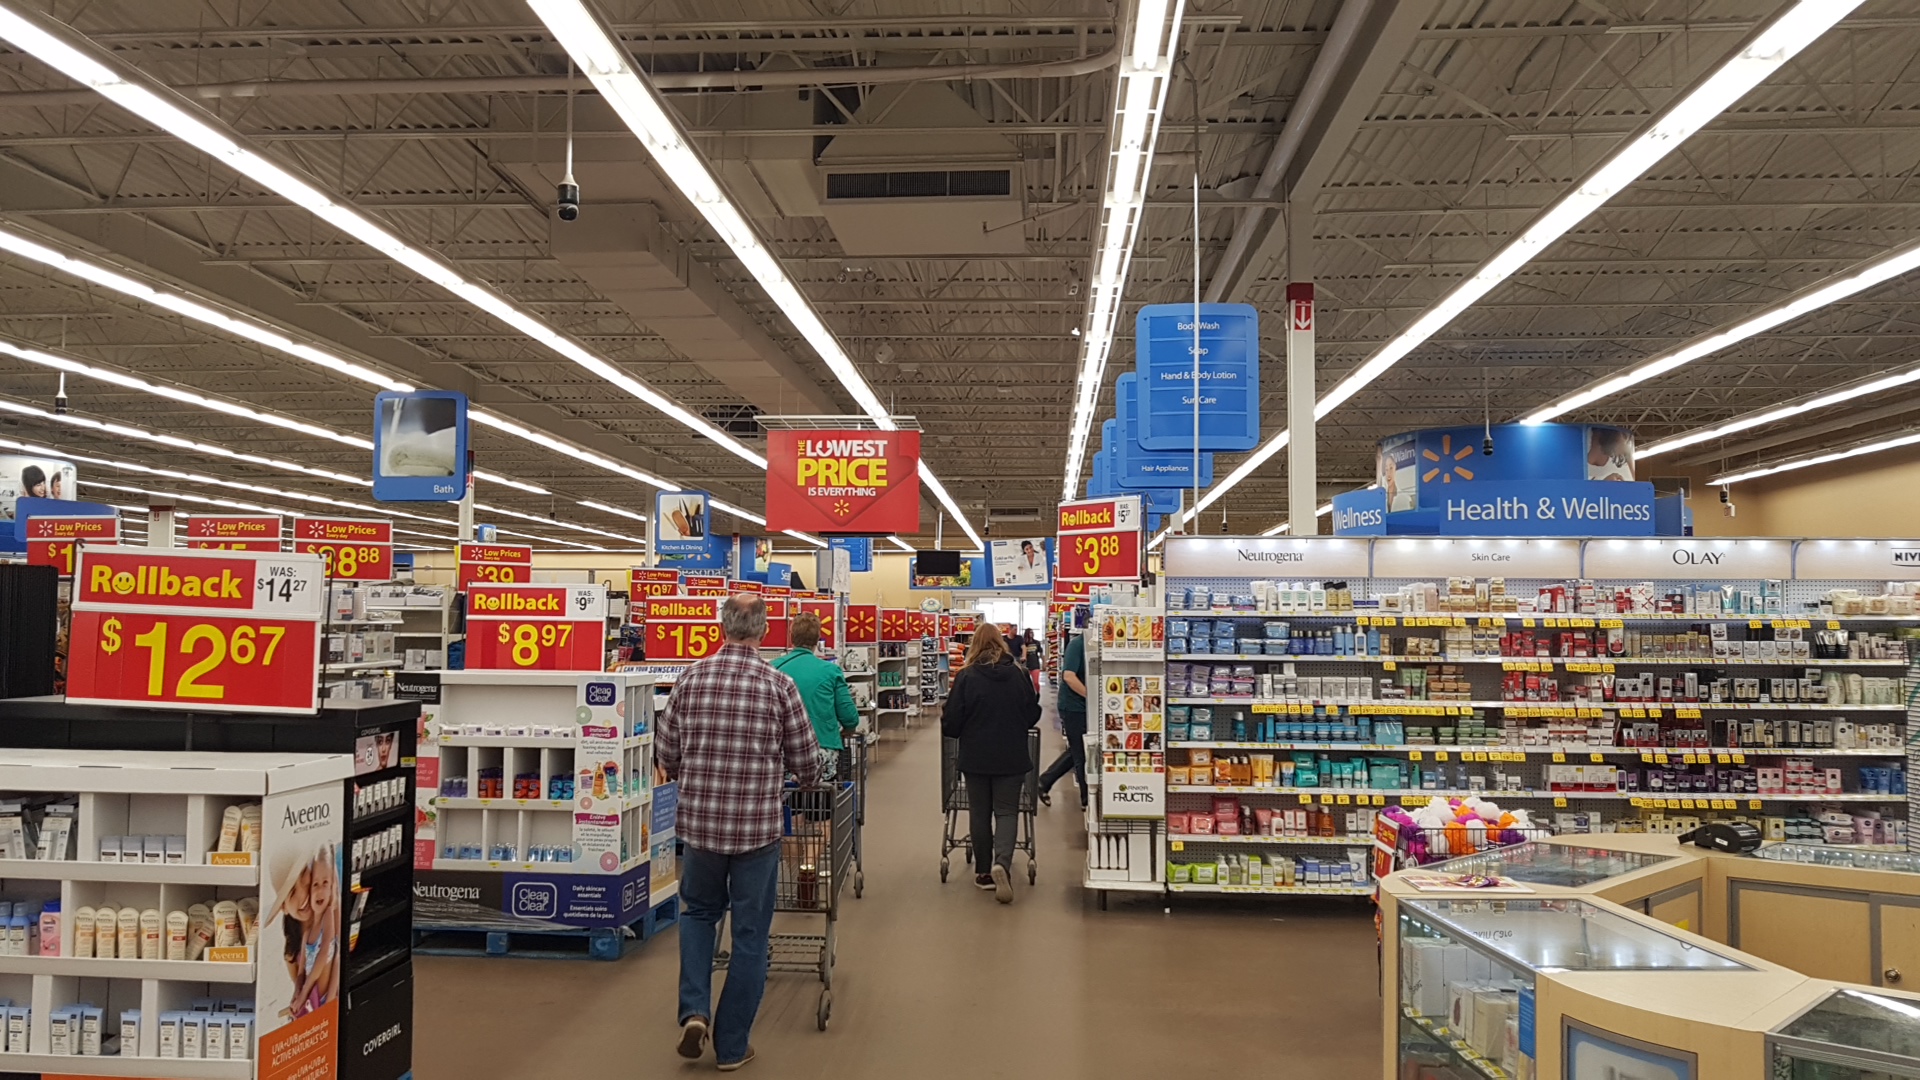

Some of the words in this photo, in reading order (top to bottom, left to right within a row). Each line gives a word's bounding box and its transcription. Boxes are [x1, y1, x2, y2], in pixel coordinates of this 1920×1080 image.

[1177, 322, 1197, 331] Body
[1199, 322, 1220, 330] Wash
[1188, 347, 1209, 356] Sap
[1161, 372, 1182, 380] Hand
[1191, 371, 1212, 381] Body
[1213, 371, 1237, 379] Lotion
[1199, 396, 1217, 404] Care
[806, 440, 888, 457] LOWEST
[797, 458, 888, 486] PRICE
[1155, 465, 1189, 473] Appliances
[433, 484, 454, 494] Bath
[808, 487, 817, 496] IS
[818, 487, 876, 496] EVERYTHING
[1447, 498, 1528, 521] Health
[1537, 498, 1555, 520] &
[1562, 498, 1650, 521] Wellness
[1061, 507, 1111, 526] Rollback
[1334, 507, 1382, 530] Wellness
[54, 522, 73, 531] Low
[75, 522, 102, 531] Prices
[217, 522, 237, 531] Low
[238, 522, 266, 531] Prices
[326, 523, 347, 533] Low
[348, 525, 377, 535] Prices
[484, 548, 499, 557] Low
[500, 549, 521, 558] Prices
[1237, 549, 1304, 564] Neutrogena
[1472, 553, 1489, 562] Skin
[1491, 553, 1511, 562] Care
[1673, 549, 1724, 565] OLAY
[1895, 552, 1920, 561] NIV
[270, 566, 297, 577] WAS:
[91, 564, 242, 599] Rollback
[474, 593, 560, 611] Rollback
[651, 603, 712, 616] Rollback
[396, 683, 437, 694] Neutrogena
[589, 685, 611, 696] Clean
[1113, 792, 1154, 802] FRUCTIS
[281, 803, 330, 830] Aveeno
[212, 855, 247, 864] Aveeno
[413, 881, 480, 901] Neutrogena
[519, 888, 549, 901] Clean
[211, 951, 245, 960] Aveeno
[363, 1023, 402, 1056] COVERGIRL
